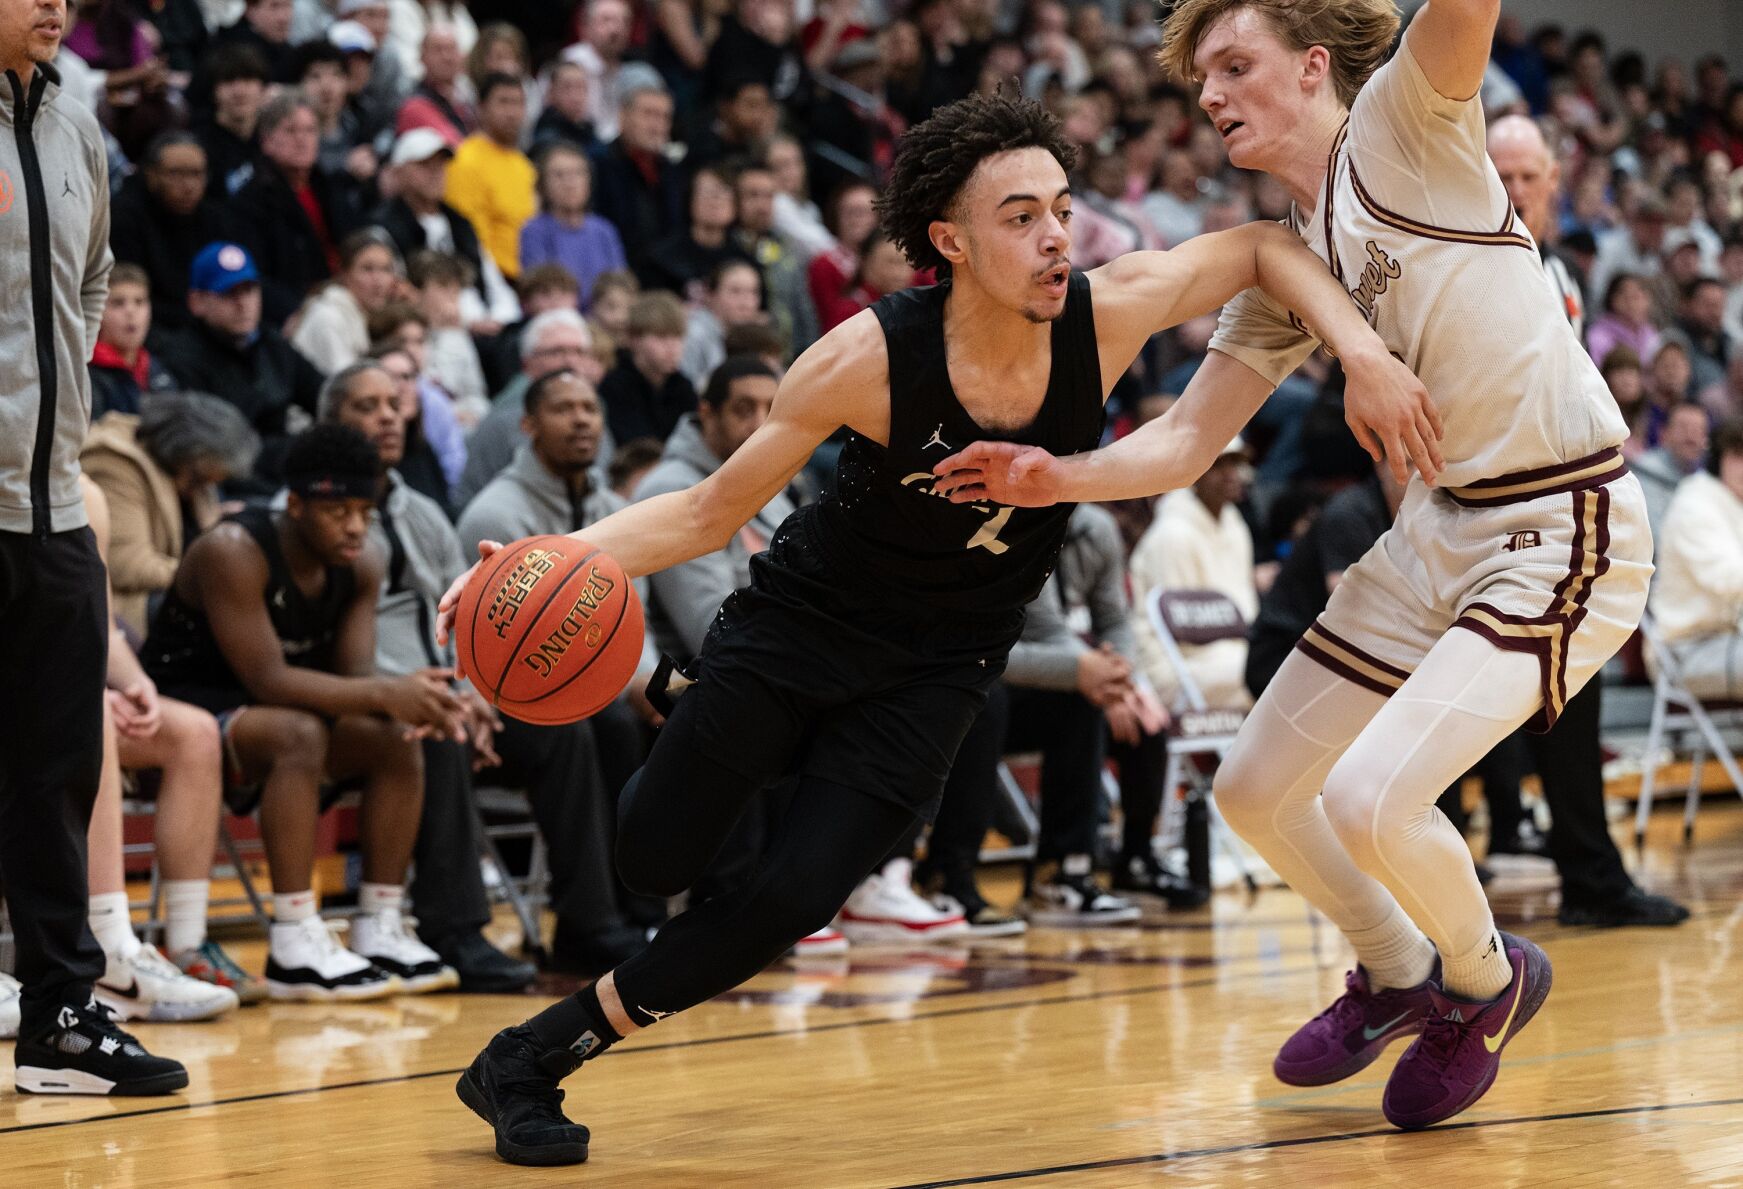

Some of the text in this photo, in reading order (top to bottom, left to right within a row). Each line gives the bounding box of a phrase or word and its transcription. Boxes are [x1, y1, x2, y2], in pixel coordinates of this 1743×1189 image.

[1350, 240, 1401, 319] met
[487, 564, 524, 621] 1000
[494, 551, 567, 640] LEGACY
[523, 564, 615, 678] SPALDING
